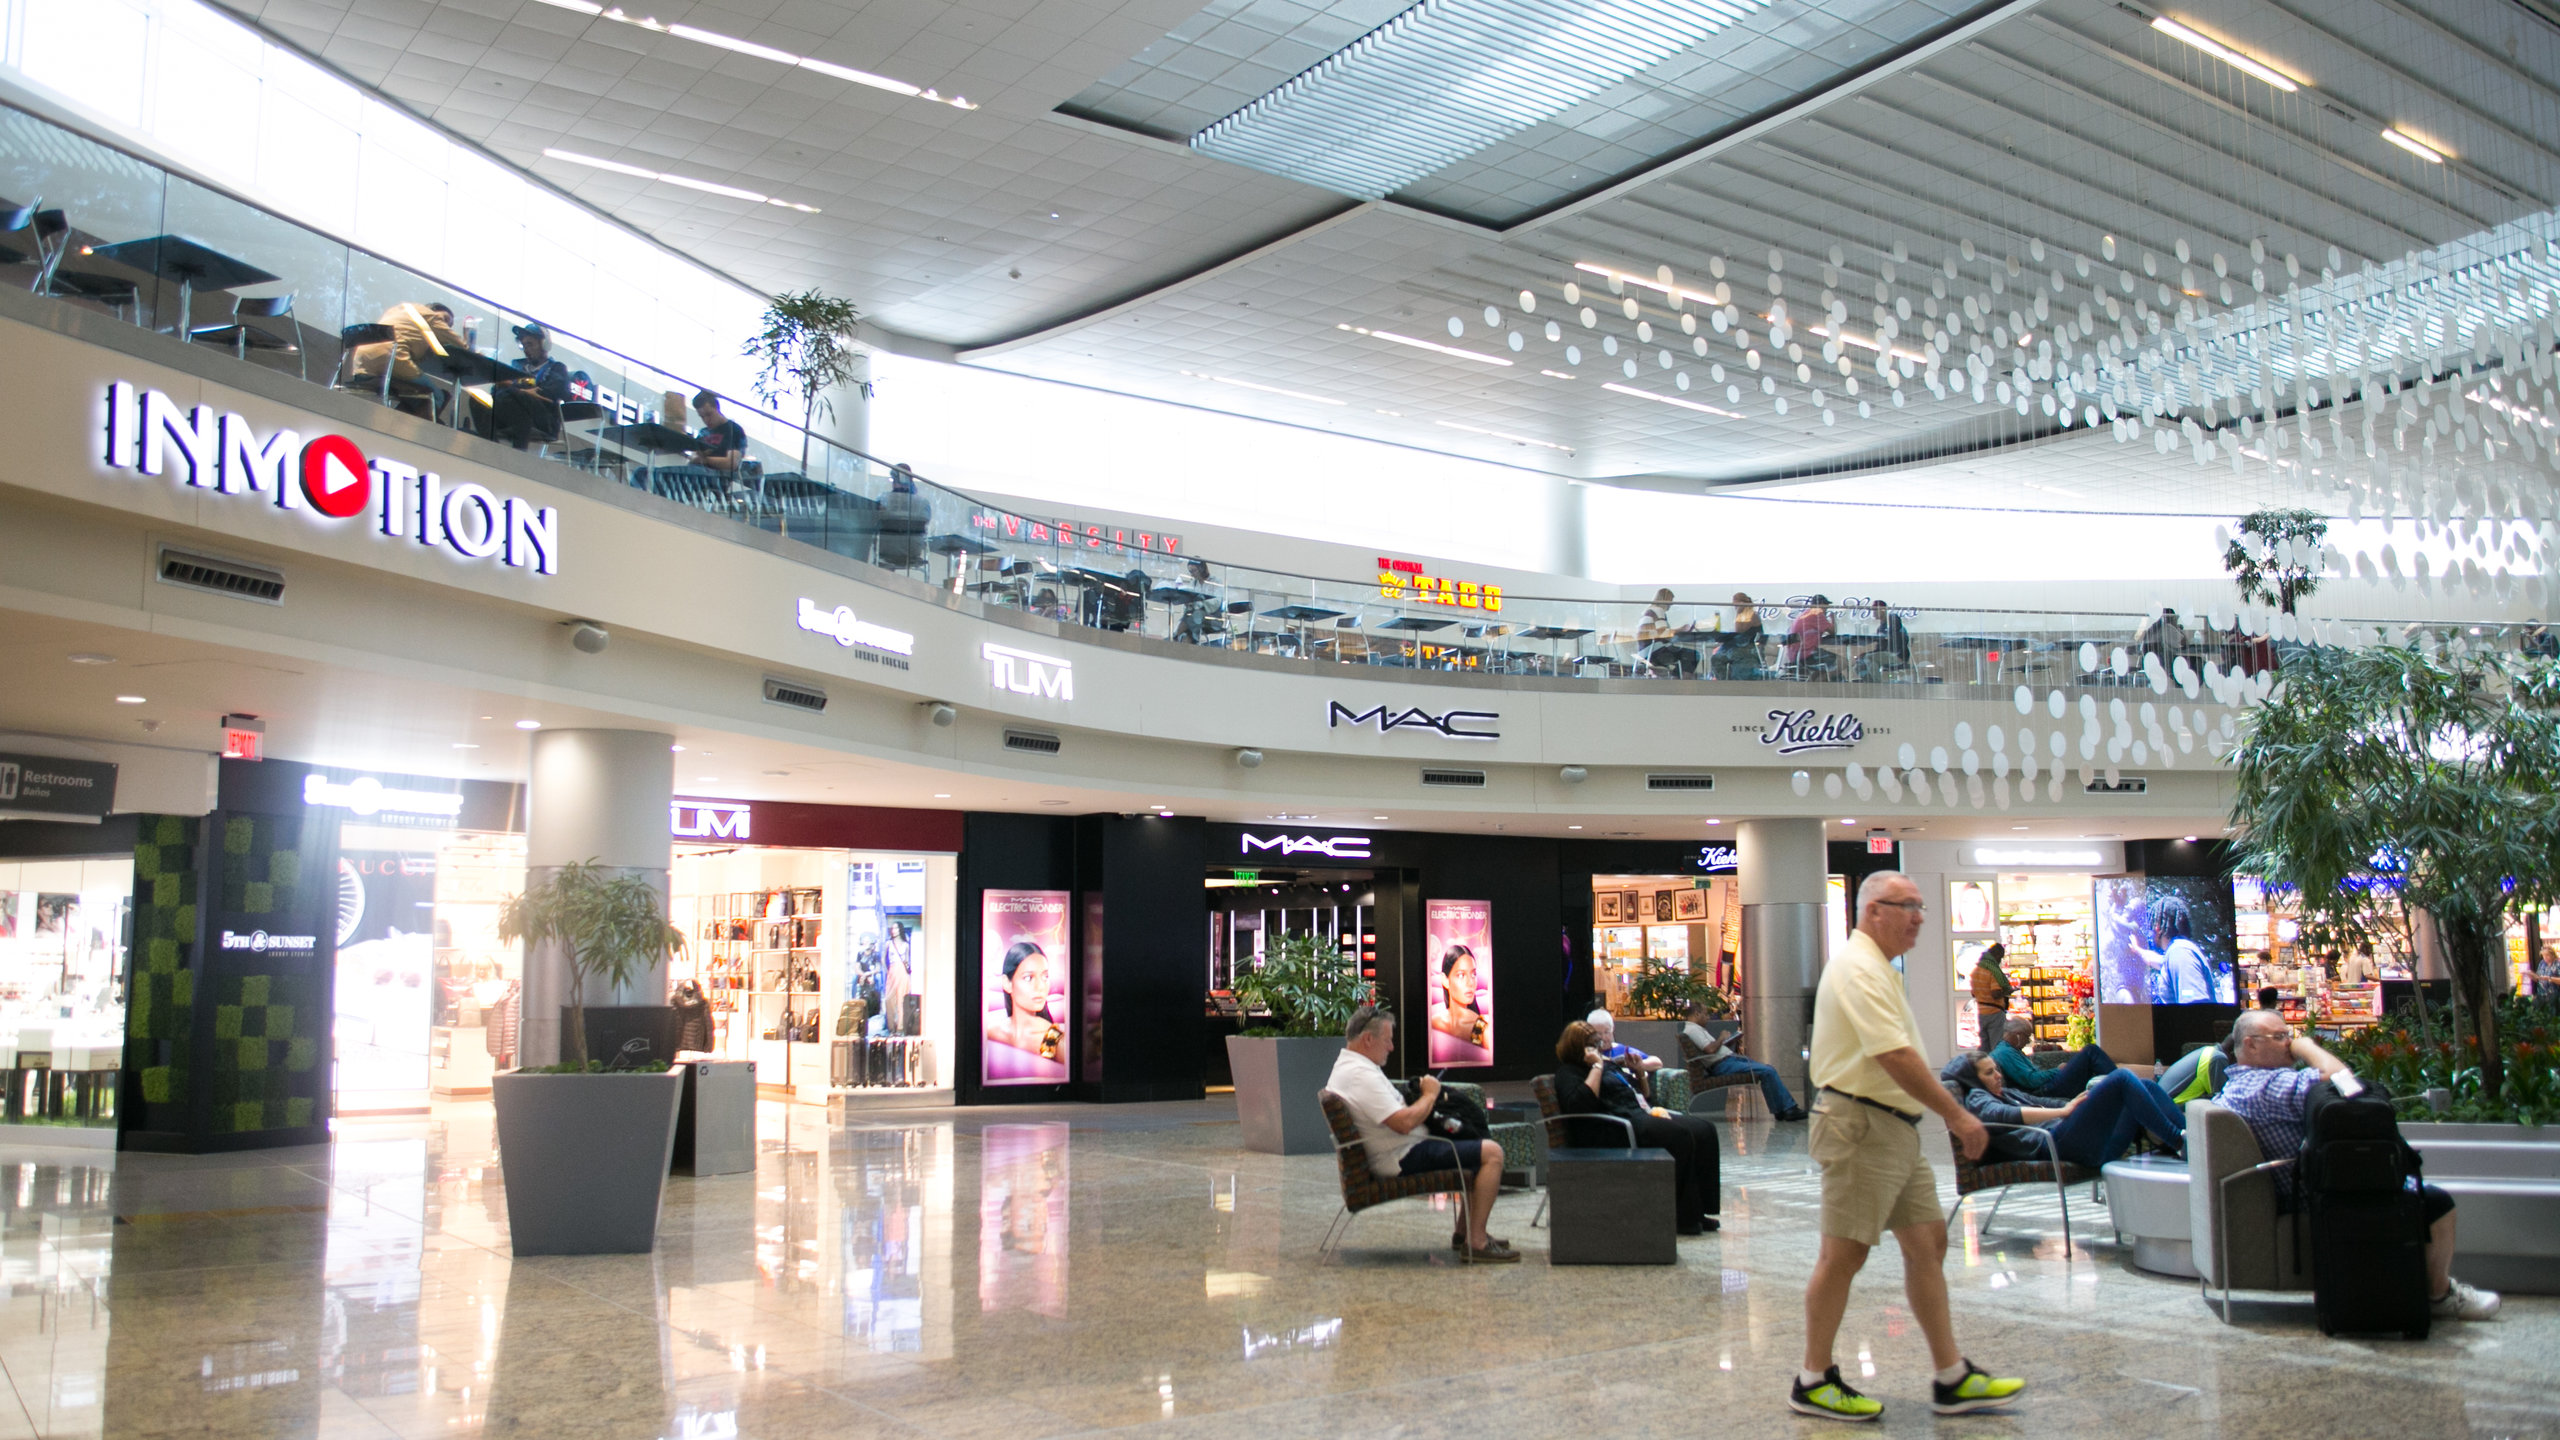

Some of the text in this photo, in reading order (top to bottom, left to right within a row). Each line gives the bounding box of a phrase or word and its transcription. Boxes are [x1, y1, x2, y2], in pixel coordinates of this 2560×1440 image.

[105, 380, 558, 576] INMOTION
[973, 514, 1179, 553] THE VARSITY
[1412, 575, 1502, 611] TACO
[982, 642, 1074, 701] TUMI
[1732, 725, 1766, 733] SINCE
[1761, 709, 1863, 745] Kiehl's
[23, 786, 51, 798] Baños
[24, 770, 94, 788] Restrooms
[669, 800, 750, 839] UMI
[990, 903, 1063, 913] ELECTRIC WONDER
[1431, 911, 1487, 920] ELECTRIC WONDER
[222, 931, 251, 948] 5TH
[268, 936, 316, 949] SUNSET
